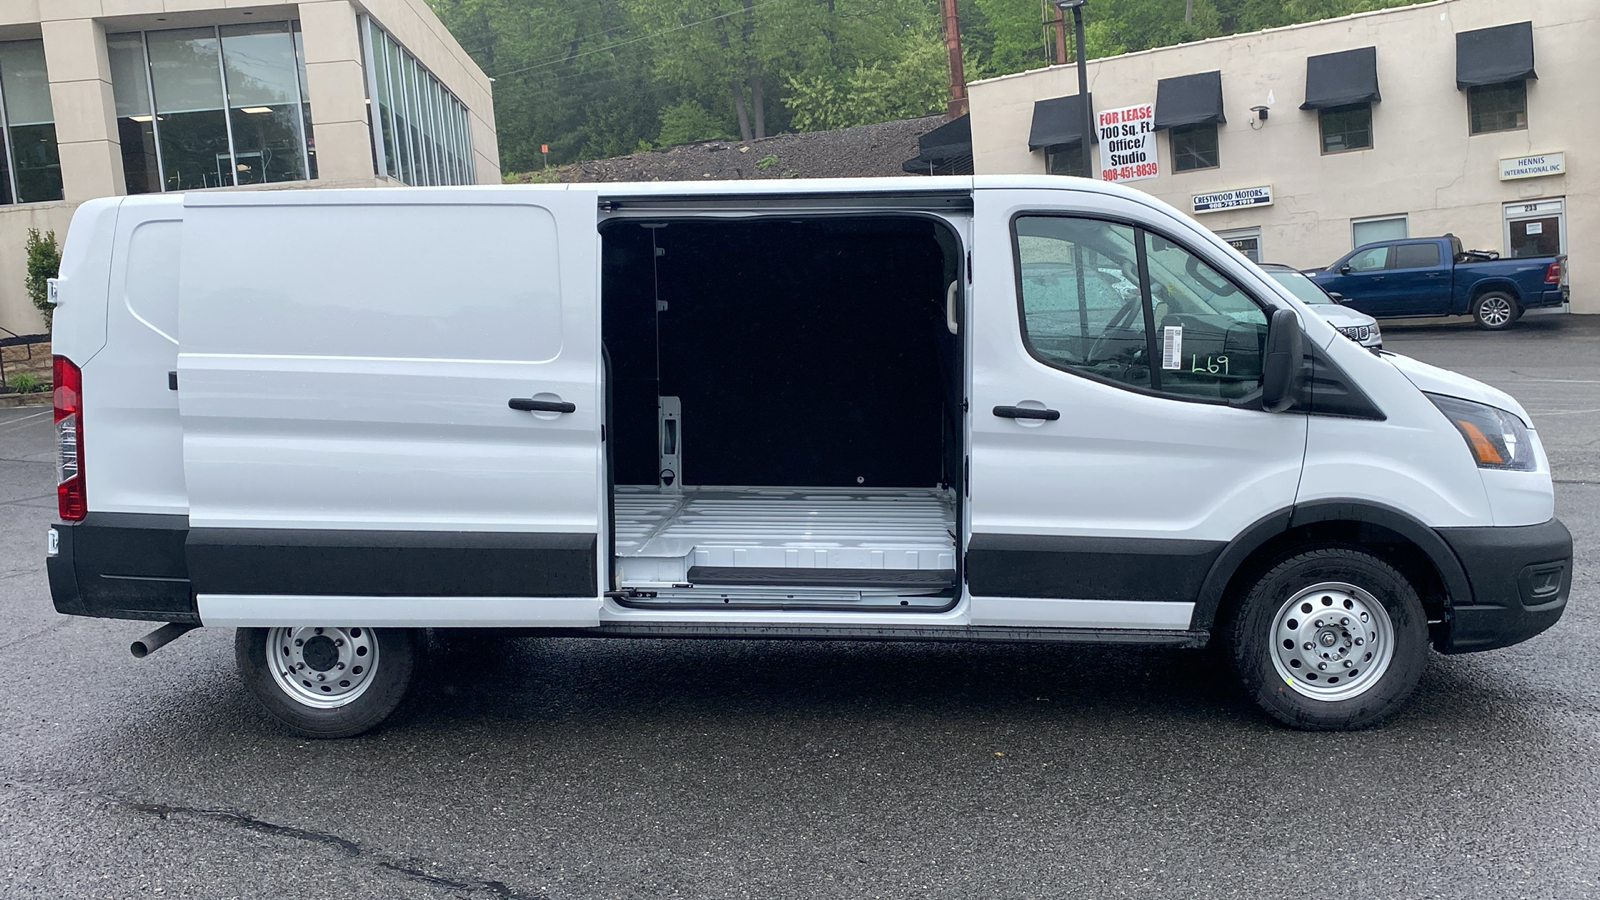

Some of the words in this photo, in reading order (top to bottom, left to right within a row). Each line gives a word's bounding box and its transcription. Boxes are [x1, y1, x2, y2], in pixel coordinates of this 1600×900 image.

[1099, 112, 1119, 126] FOR
[1121, 105, 1152, 122] LEASE
[1100, 125, 1120, 140] 700
[1121, 124, 1139, 137] Sq.
[1108, 135, 1146, 153] Office/
[1110, 151, 1147, 167] Studio
[1518, 156, 1545, 167] HENNIS
[1102, 162, 1158, 182] 908-451-8839
[1504, 166, 1549, 177] INTERNATIONAL
[1193, 192, 1233, 205] CRESTWOOD
[1235, 188, 1263, 199] MOTORS
[1524, 204, 1538, 212] 233
[1191, 353, 1229, 376] L69
